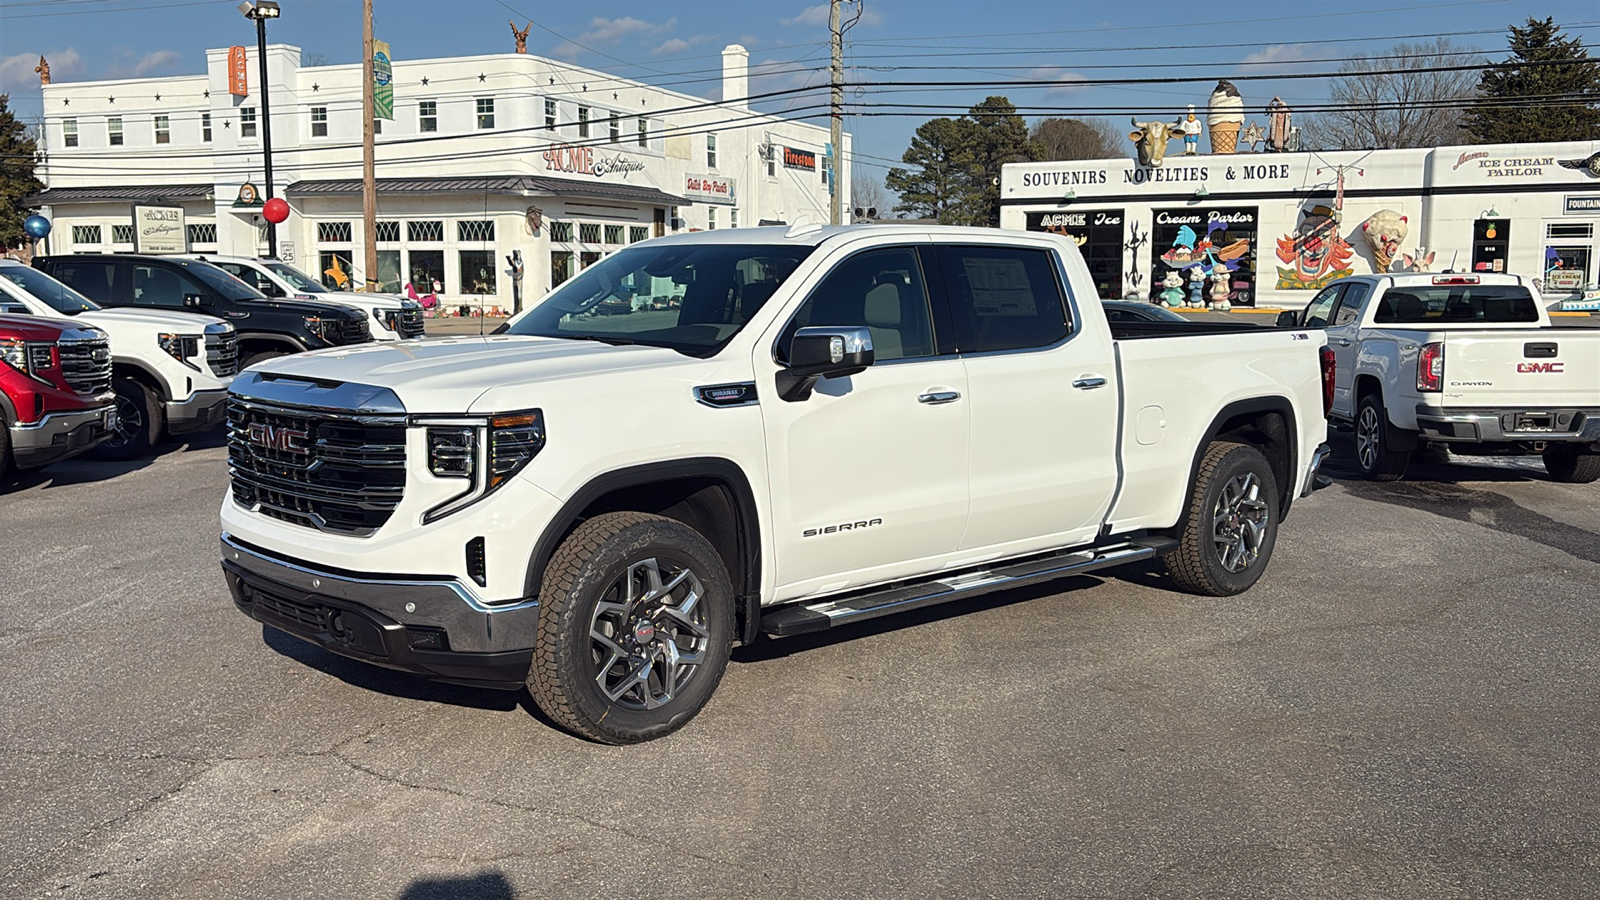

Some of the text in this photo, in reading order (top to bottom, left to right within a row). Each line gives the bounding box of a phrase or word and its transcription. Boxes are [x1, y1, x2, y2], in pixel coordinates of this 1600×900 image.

[236, 49, 246, 92] ACME
[542, 142, 594, 175] ACME
[594, 153, 645, 179] Antiques
[784, 147, 815, 168] Firestone
[1479, 158, 1554, 169] ICE CREAM
[1023, 164, 1289, 187] SOUVENIRS NOVELTIES & MORE
[1487, 168, 1543, 177] PARLOR
[687, 178, 727, 194] Dutch Boy Paints
[144, 210, 179, 221] ACME
[1041, 210, 1254, 226] ACME Ice Cream Parlor
[283, 253, 293, 261] 25
[1517, 363, 1564, 373] GMC
[248, 422, 309, 455] GMC
[803, 518, 883, 537] SIERRA
